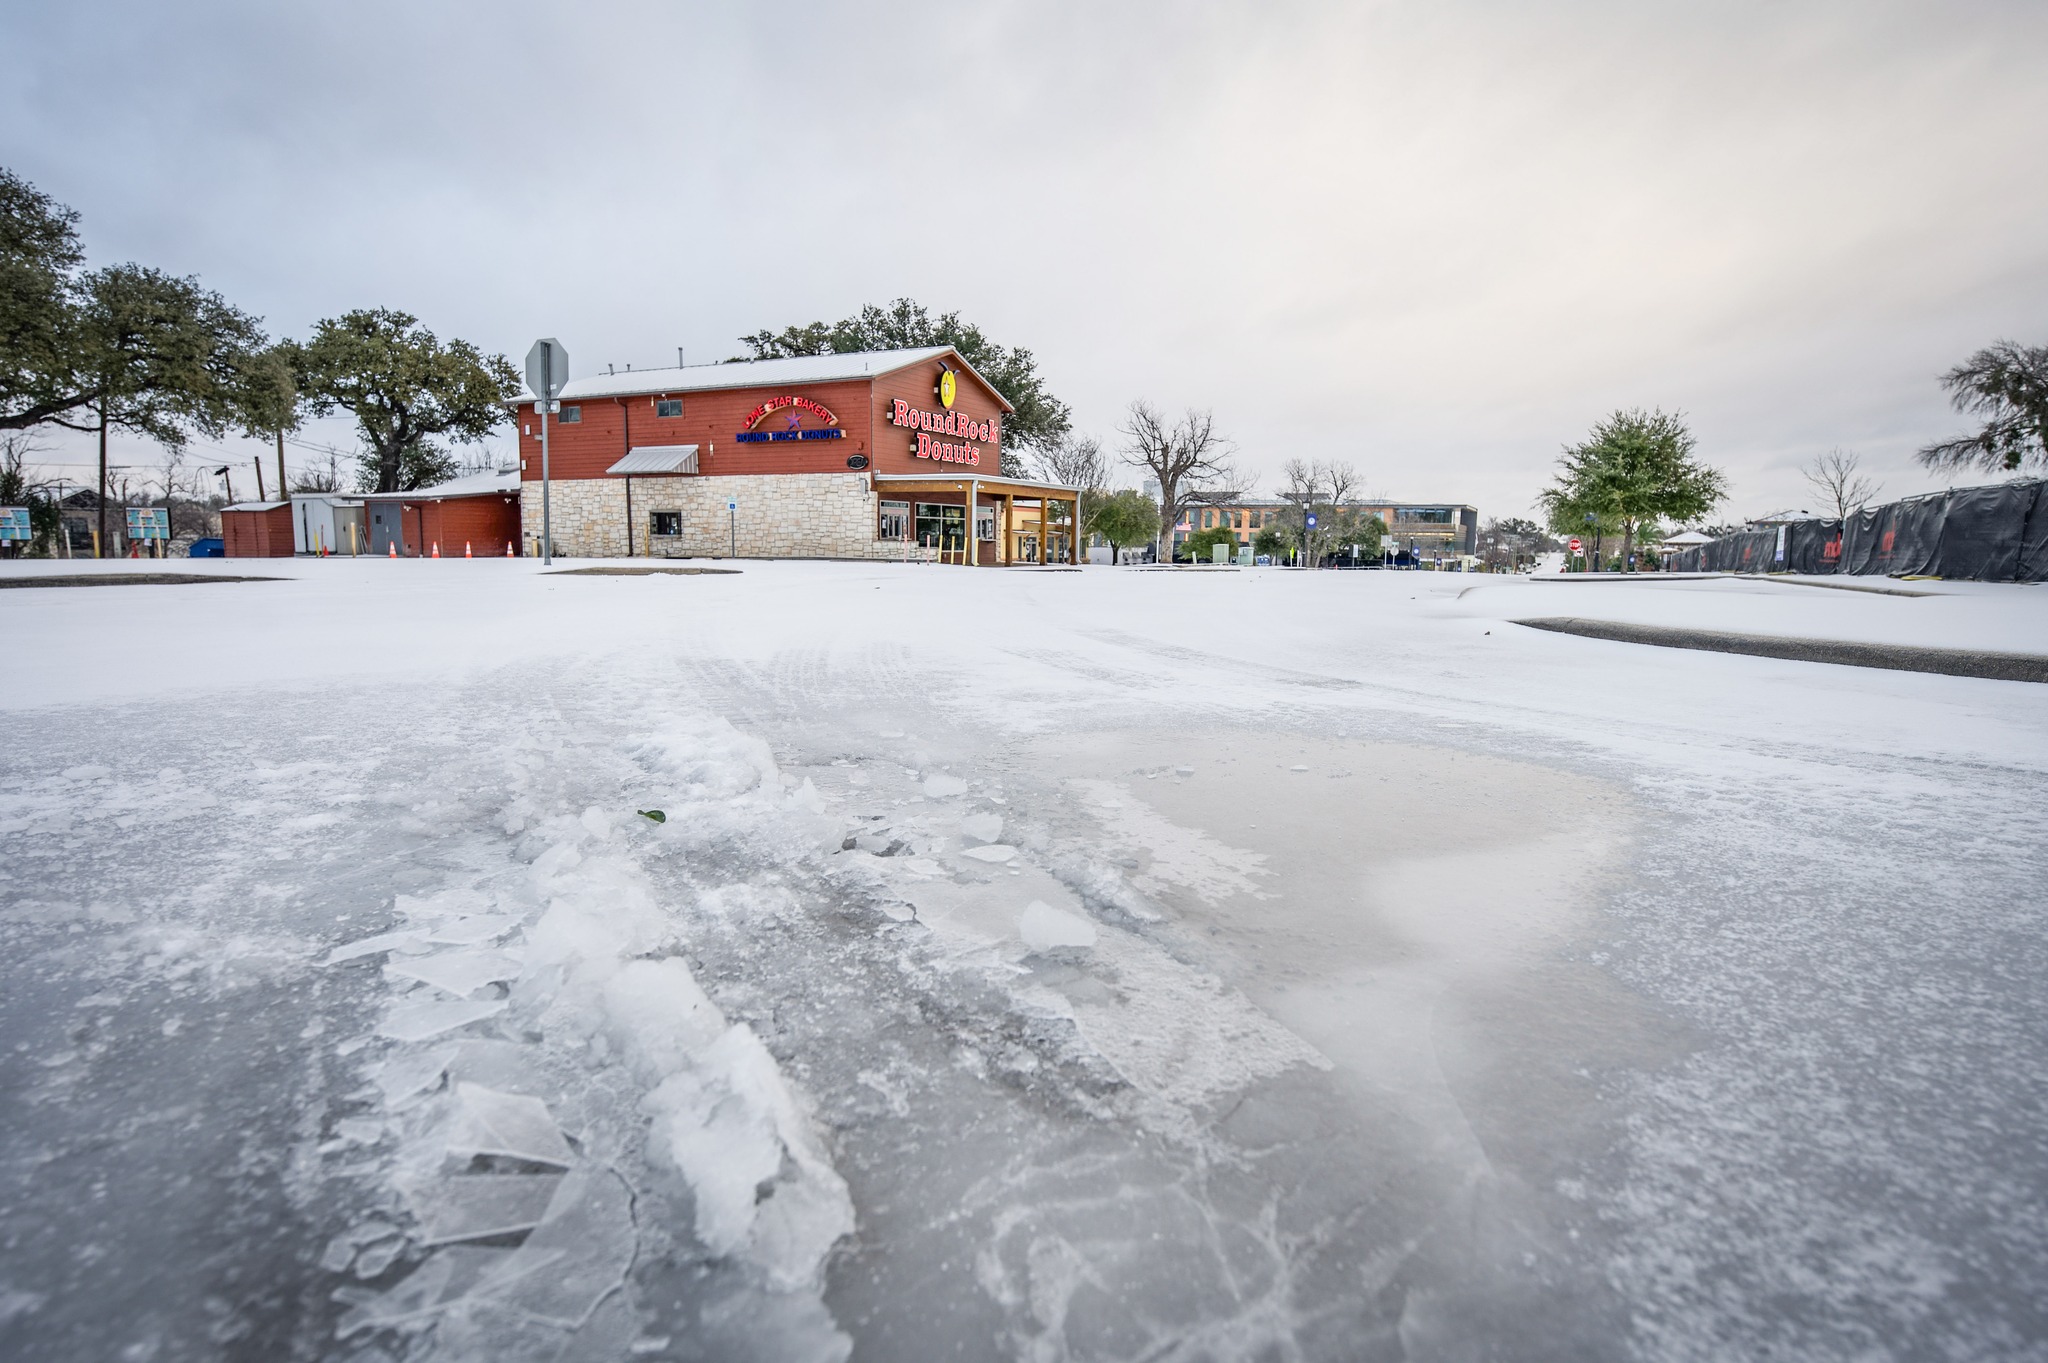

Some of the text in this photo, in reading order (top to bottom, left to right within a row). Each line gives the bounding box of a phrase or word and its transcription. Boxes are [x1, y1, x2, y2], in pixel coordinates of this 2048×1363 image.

[742, 396, 834, 429] LONE STAR BAKERY
[736, 429, 842, 443] ROUND ROCK DONUTS
[916, 432, 980, 467] Donuts
